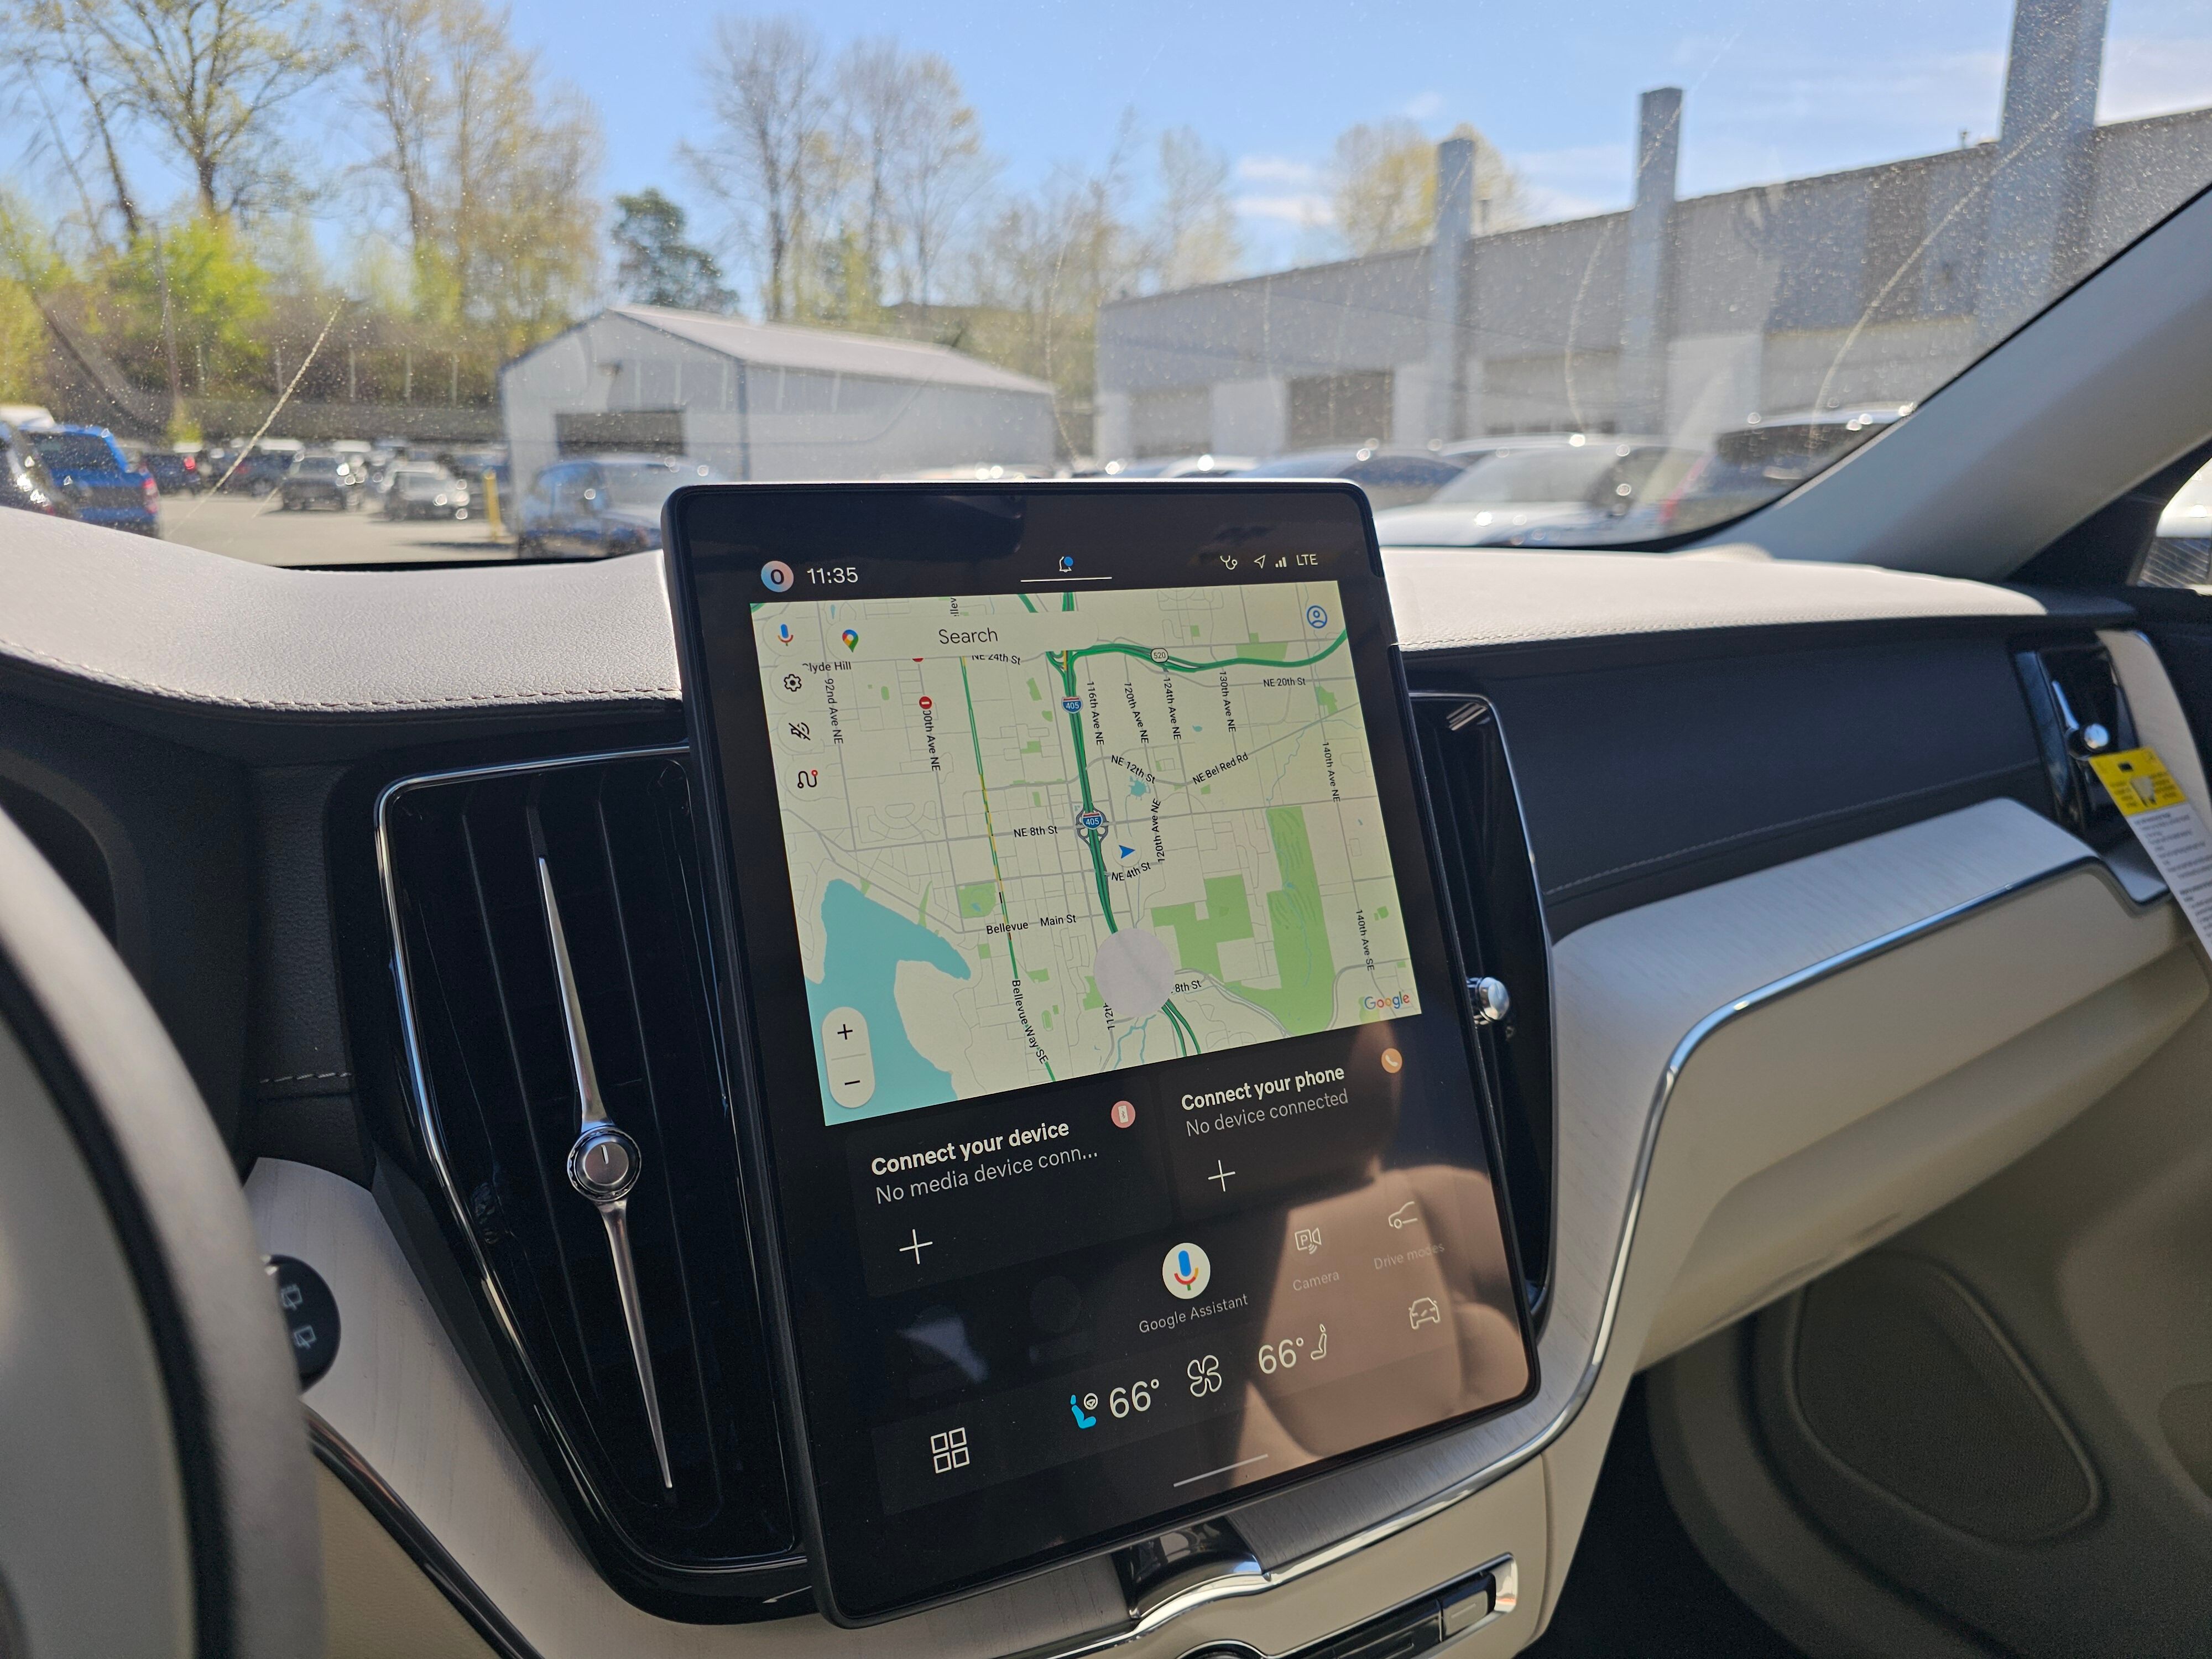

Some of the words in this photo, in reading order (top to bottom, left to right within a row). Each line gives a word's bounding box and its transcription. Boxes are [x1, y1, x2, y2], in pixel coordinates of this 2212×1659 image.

[1296, 554, 1318, 566] LTE
[807, 567, 859, 585] 11:35
[950, 597, 959, 617] llev
[938, 627, 998, 644] Search
[834, 661, 852, 671] Hill
[1011, 655, 1021, 665] St
[825, 678, 838, 704] 92nd
[1163, 677, 1175, 704] 124th
[1219, 671, 1230, 697] 130th
[1263, 679, 1275, 687] NE
[1277, 678, 1295, 687] 20th
[1298, 677, 1306, 686] St
[1087, 681, 1098, 708] 116th
[1065, 701, 1079, 710] 405
[1124, 682, 1137, 709] 120th
[1133, 711, 1144, 728] Ave
[1139, 730, 1150, 744] NE
[1168, 706, 1177, 724] Ave
[1223, 699, 1232, 717] Ave
[829, 707, 838, 727] Ave
[922, 710, 935, 732] 00th
[1092, 711, 1100, 729] Ave
[1227, 719, 1237, 733] NE
[832, 729, 844, 745] NE
[1095, 731, 1105, 746] NE
[1172, 726, 1182, 741] NE
[926, 735, 936, 754] Ave
[930, 757, 941, 772] NE
[1323, 742, 1333, 768] 140th
[1111, 755, 1124, 766] NE
[1126, 761, 1144, 778] 12th
[1145, 774, 1156, 784] St
[1192, 774, 1207, 785] NE
[1205, 765, 1220, 778] Bel
[1219, 757, 1237, 772] Red
[1237, 752, 1249, 764] Rd
[1327, 770, 1336, 787] Ave
[1150, 798, 1161, 813] NE
[1332, 789, 1340, 803] NE
[1014, 828, 1027, 838] NE
[1030, 826, 1045, 836] 8th
[1048, 826, 1058, 834] St
[1151, 815, 1160, 833] Ave
[1153, 835, 1165, 863] 120th
[1112, 872, 1125, 881] NE
[1126, 867, 1141, 878] 4th
[1141, 862, 1151, 872] St
[986, 922, 1029, 935] Bellevue
[1040, 916, 1064, 927] Main
[1066, 914, 1077, 924] St
[1356, 910, 1367, 936] 140th
[1361, 938, 1370, 956] Ave
[1366, 958, 1375, 972] SE
[1175, 982, 1190, 993] 8th
[1191, 979, 1202, 989] St
[1364, 991, 1410, 1010] Google
[1012, 979, 1028, 1025] Bellevue
[1025, 1025, 1039, 1048] Way
[1036, 1049, 1049, 1065] SE
[1181, 1082, 1253, 1110] Connect
[1254, 1082, 1291, 1100] your
[1295, 1067, 1345, 1093] phone
[1186, 1119, 1210, 1137] No
[1214, 1108, 1265, 1130] device
[1269, 1088, 1349, 1119] connected
[871, 1142, 957, 1176] Connect
[959, 1135, 1004, 1161] your
[1008, 1123, 1070, 1147] device
[875, 1186, 905, 1204] No
[910, 1170, 969, 1197] media
[974, 1158, 1034, 1183] device
[1038, 1150, 1098, 1169] conn...
[1373, 1252, 1405, 1270] Drive
[1407, 1243, 1446, 1261] modes
[1292, 1271, 1339, 1291] Camera
[1139, 1310, 1187, 1333] Google
[1190, 1293, 1249, 1320] Assistant
[1258, 1337, 1304, 1374] 66°
[1109, 1379, 1160, 1418] 66°
